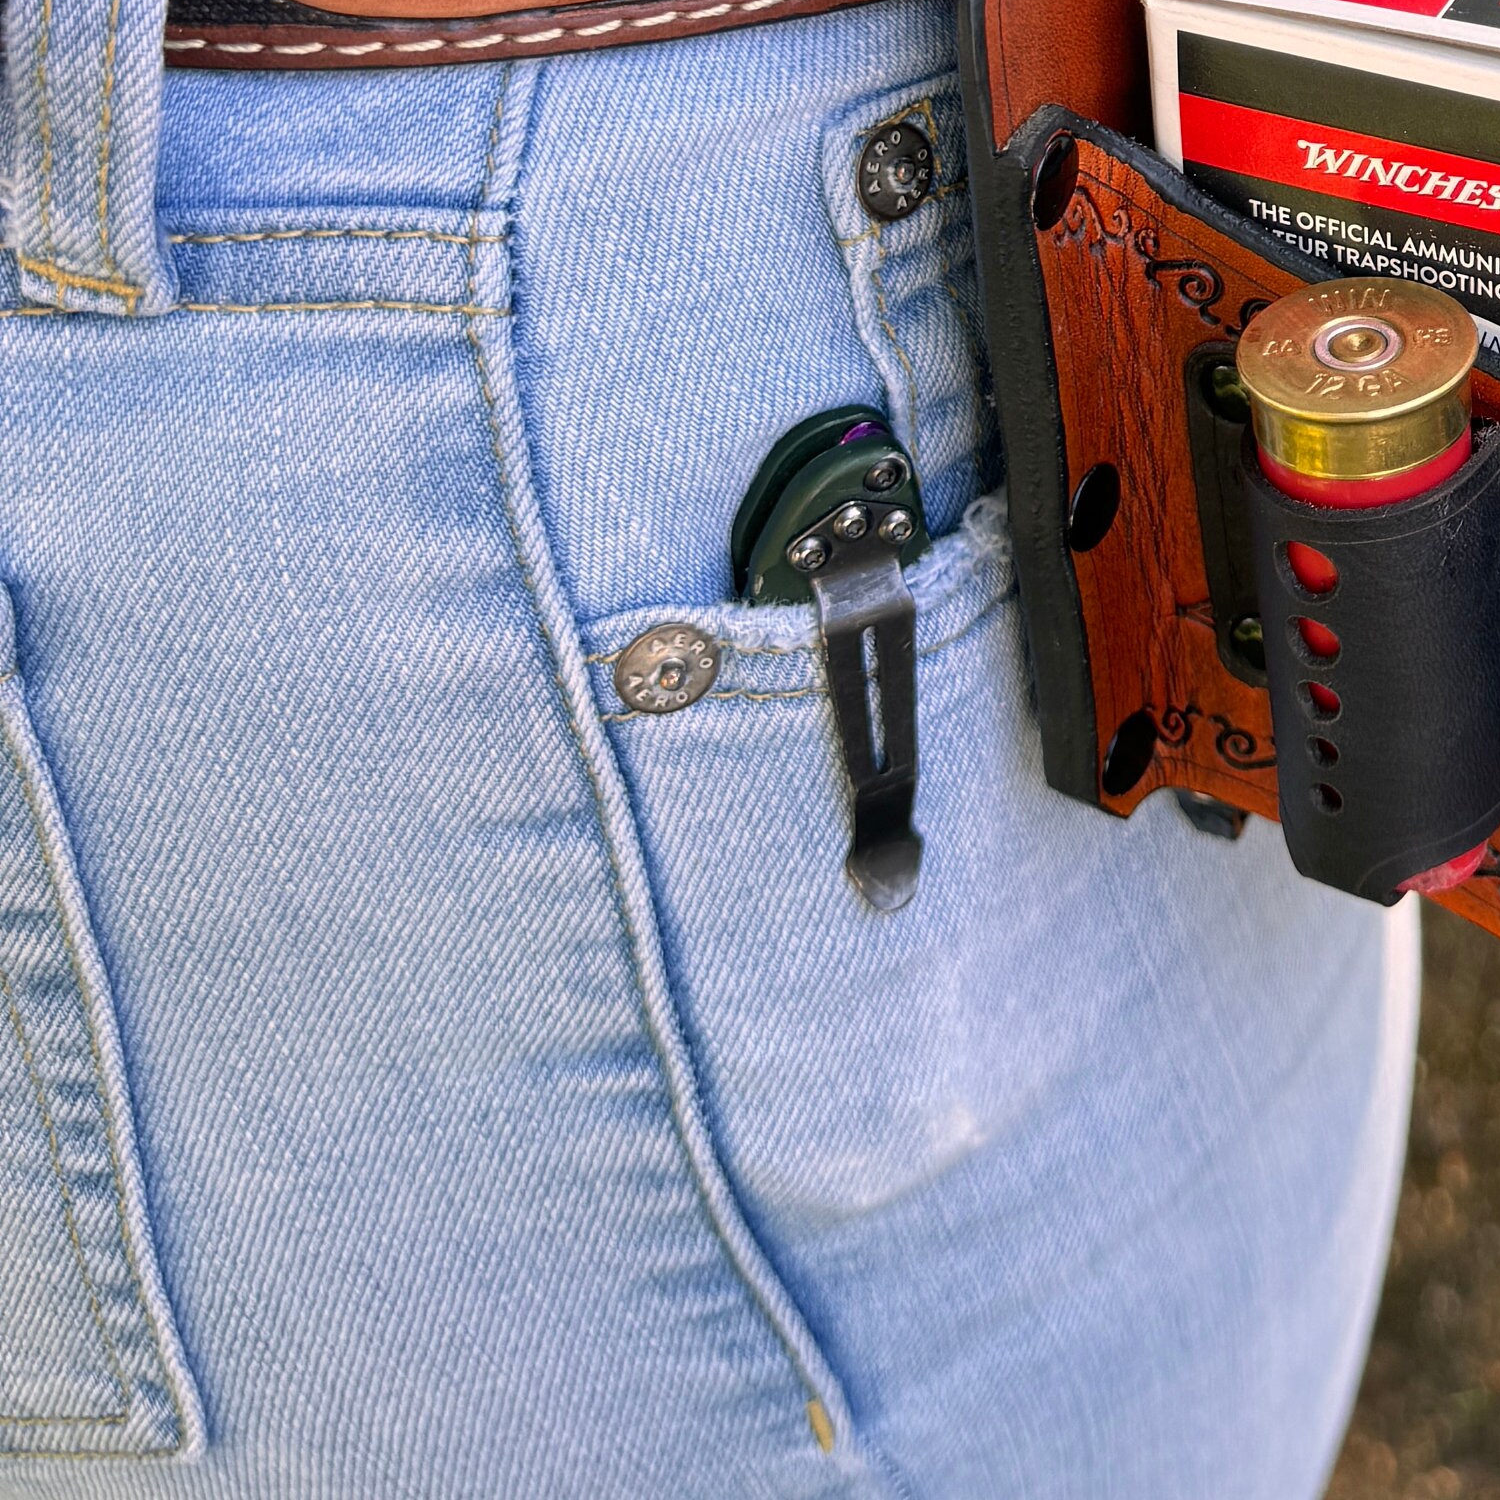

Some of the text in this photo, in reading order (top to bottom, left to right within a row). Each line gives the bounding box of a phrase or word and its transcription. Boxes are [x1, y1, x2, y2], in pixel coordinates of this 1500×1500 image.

[866, 130, 901, 194] AERO
[897, 148, 930, 210] AERO
[1249, 199, 1291, 226] THE
[1296, 211, 1398, 251] OFFICIAL
[1304, 370, 1413, 400] 12 GA
[651, 632, 714, 669] AERO
[628, 675, 689, 708] AERO
